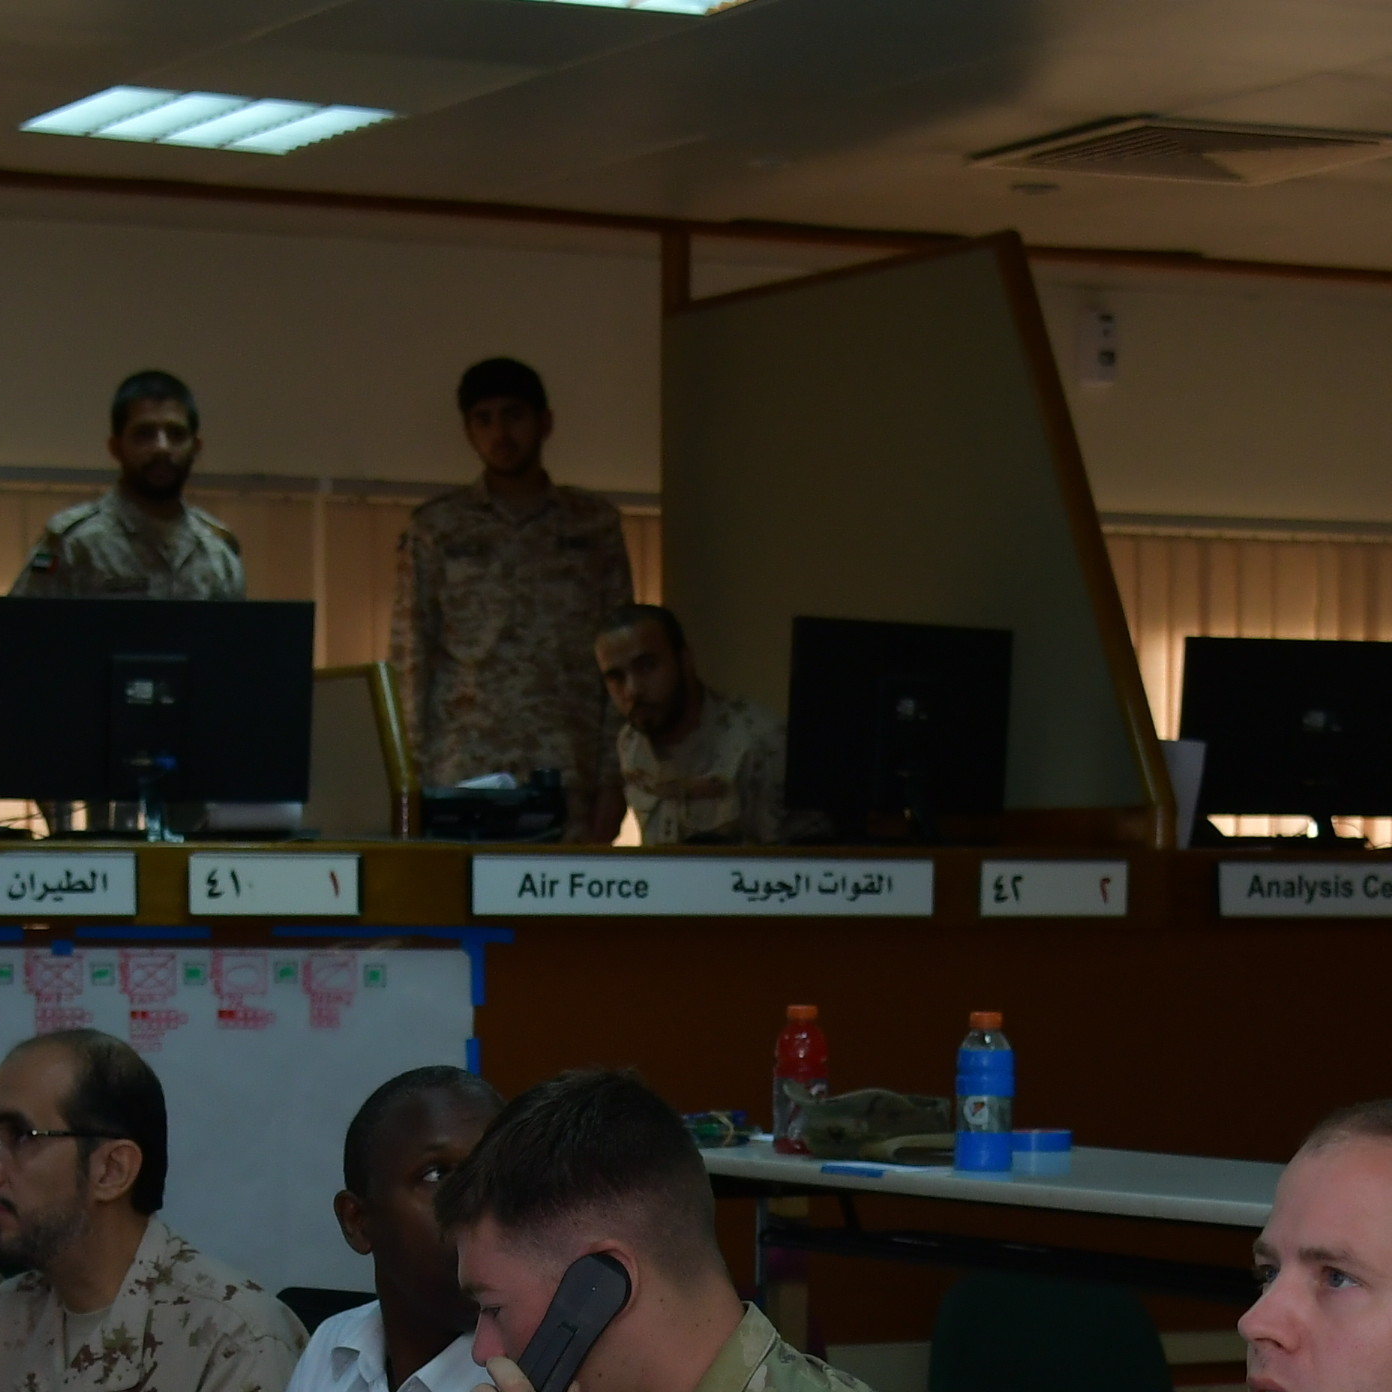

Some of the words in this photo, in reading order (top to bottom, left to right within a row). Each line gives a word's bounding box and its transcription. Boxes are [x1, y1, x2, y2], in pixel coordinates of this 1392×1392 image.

[8, 869, 108, 902] الطيران
[518, 872, 558, 899] Air
[569, 872, 650, 900] Force
[731, 870, 808, 904] الجوية
[817, 871, 893, 903] القوات
[1246, 874, 1354, 904] Analysis
